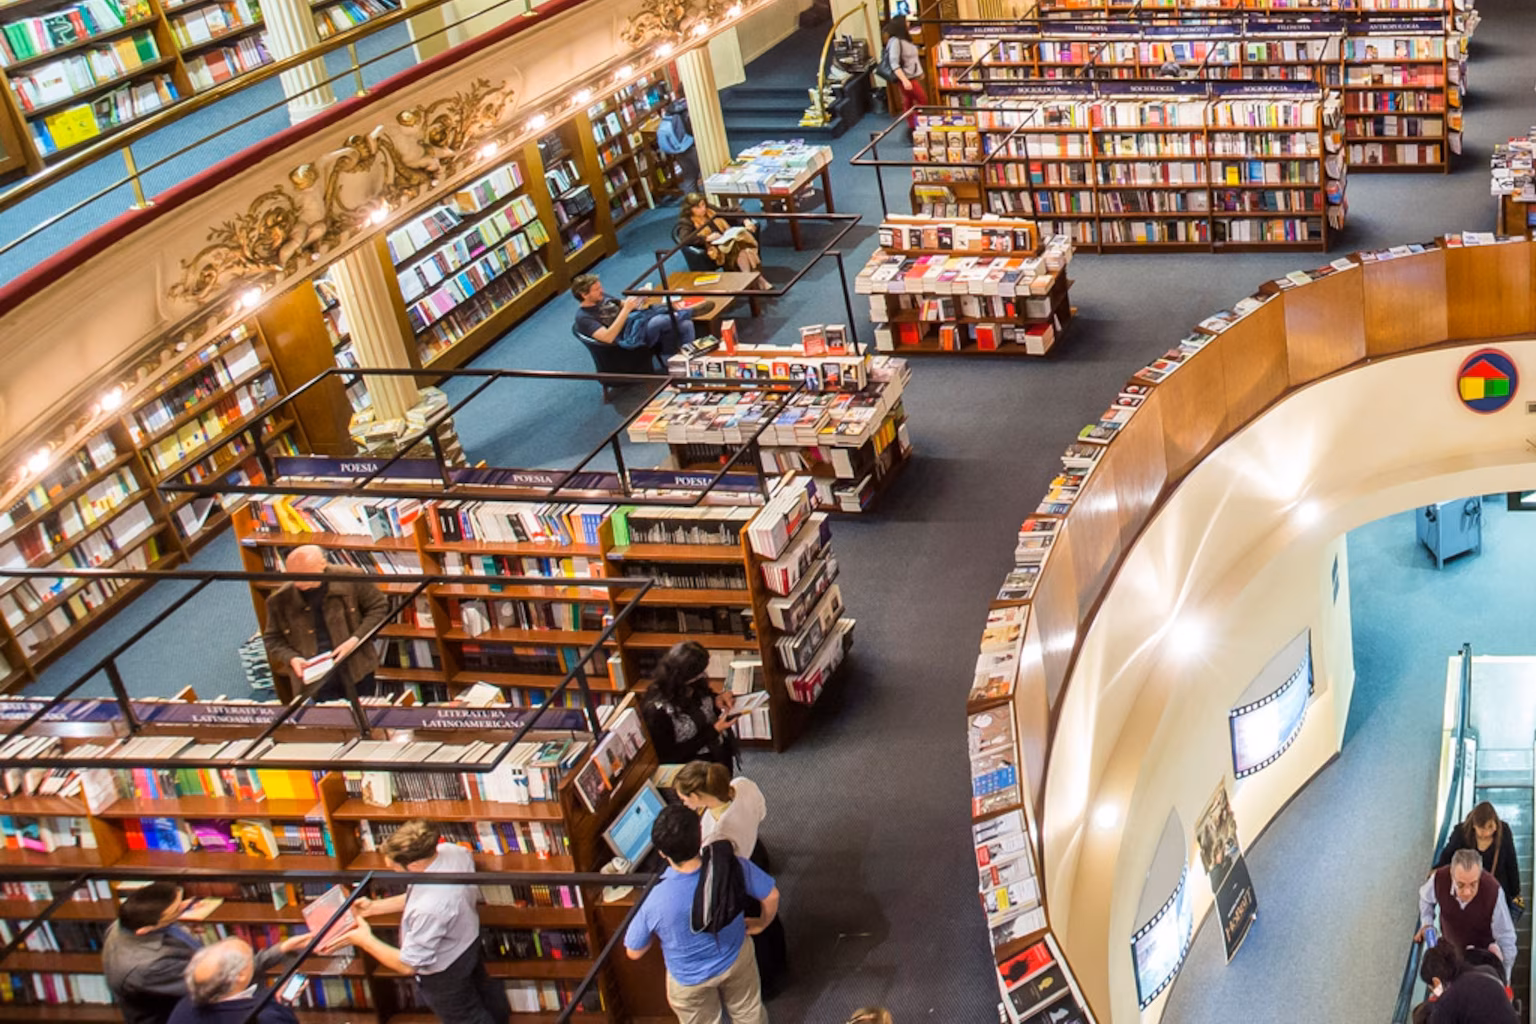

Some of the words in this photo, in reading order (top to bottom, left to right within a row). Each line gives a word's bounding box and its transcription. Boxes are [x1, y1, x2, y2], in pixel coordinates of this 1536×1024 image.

[1129, 85, 1175, 93] SOCIOLOGIA
[340, 462, 378, 473] POESIA
[512, 474, 554, 484] POESIA
[437, 709, 507, 718] LITERATURA
